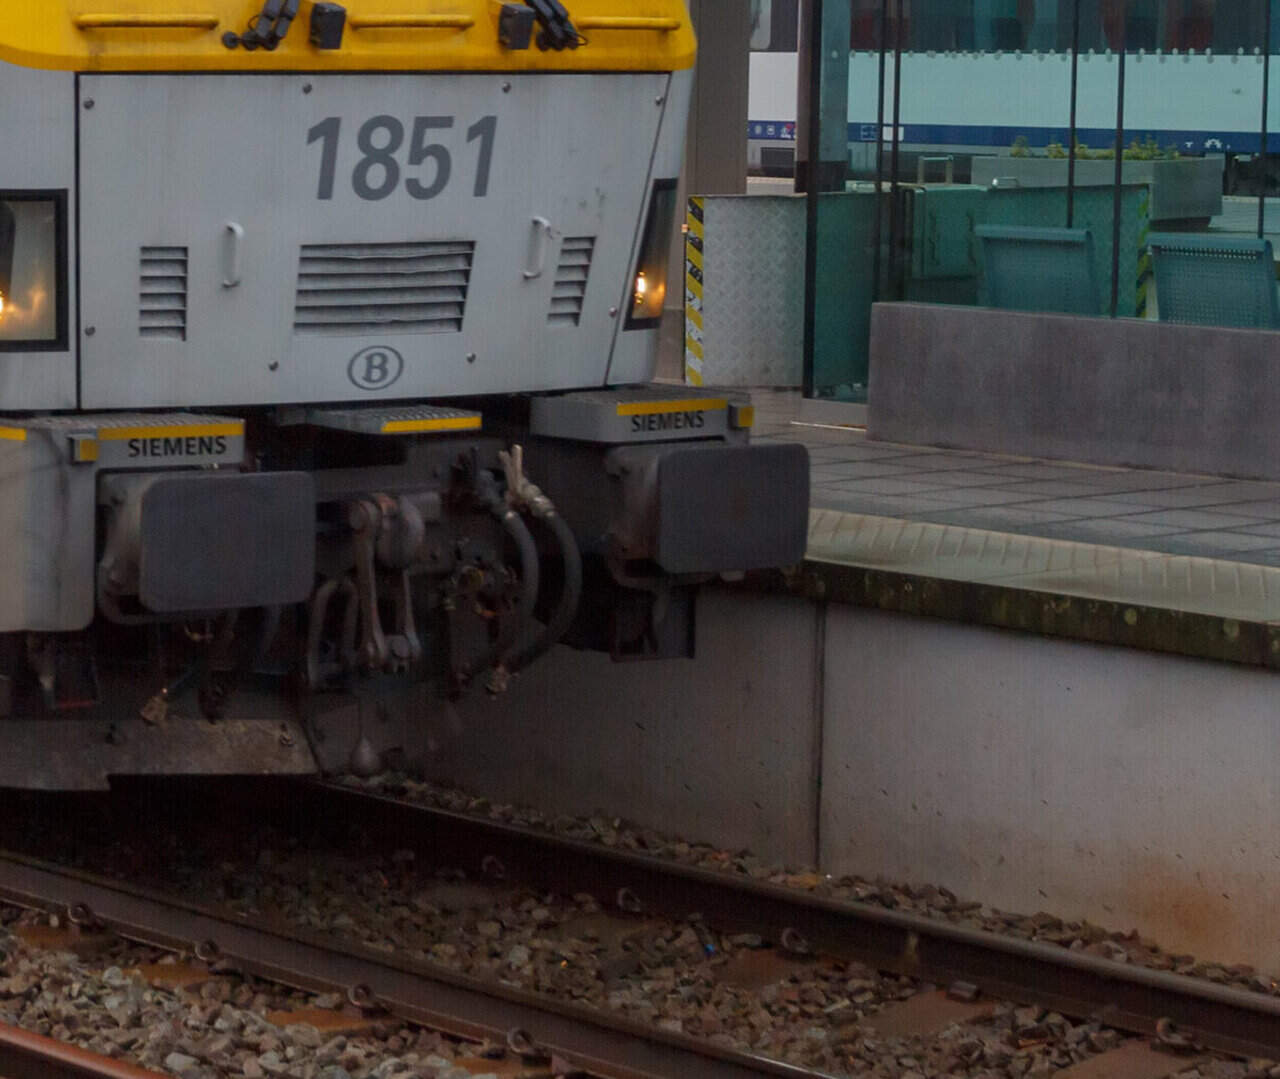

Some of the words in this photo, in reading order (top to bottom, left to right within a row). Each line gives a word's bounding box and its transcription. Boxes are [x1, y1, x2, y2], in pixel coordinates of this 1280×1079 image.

[306, 115, 497, 200] 1851
[631, 410, 704, 432] SIEMENS
[128, 436, 226, 458] SIEMENS
